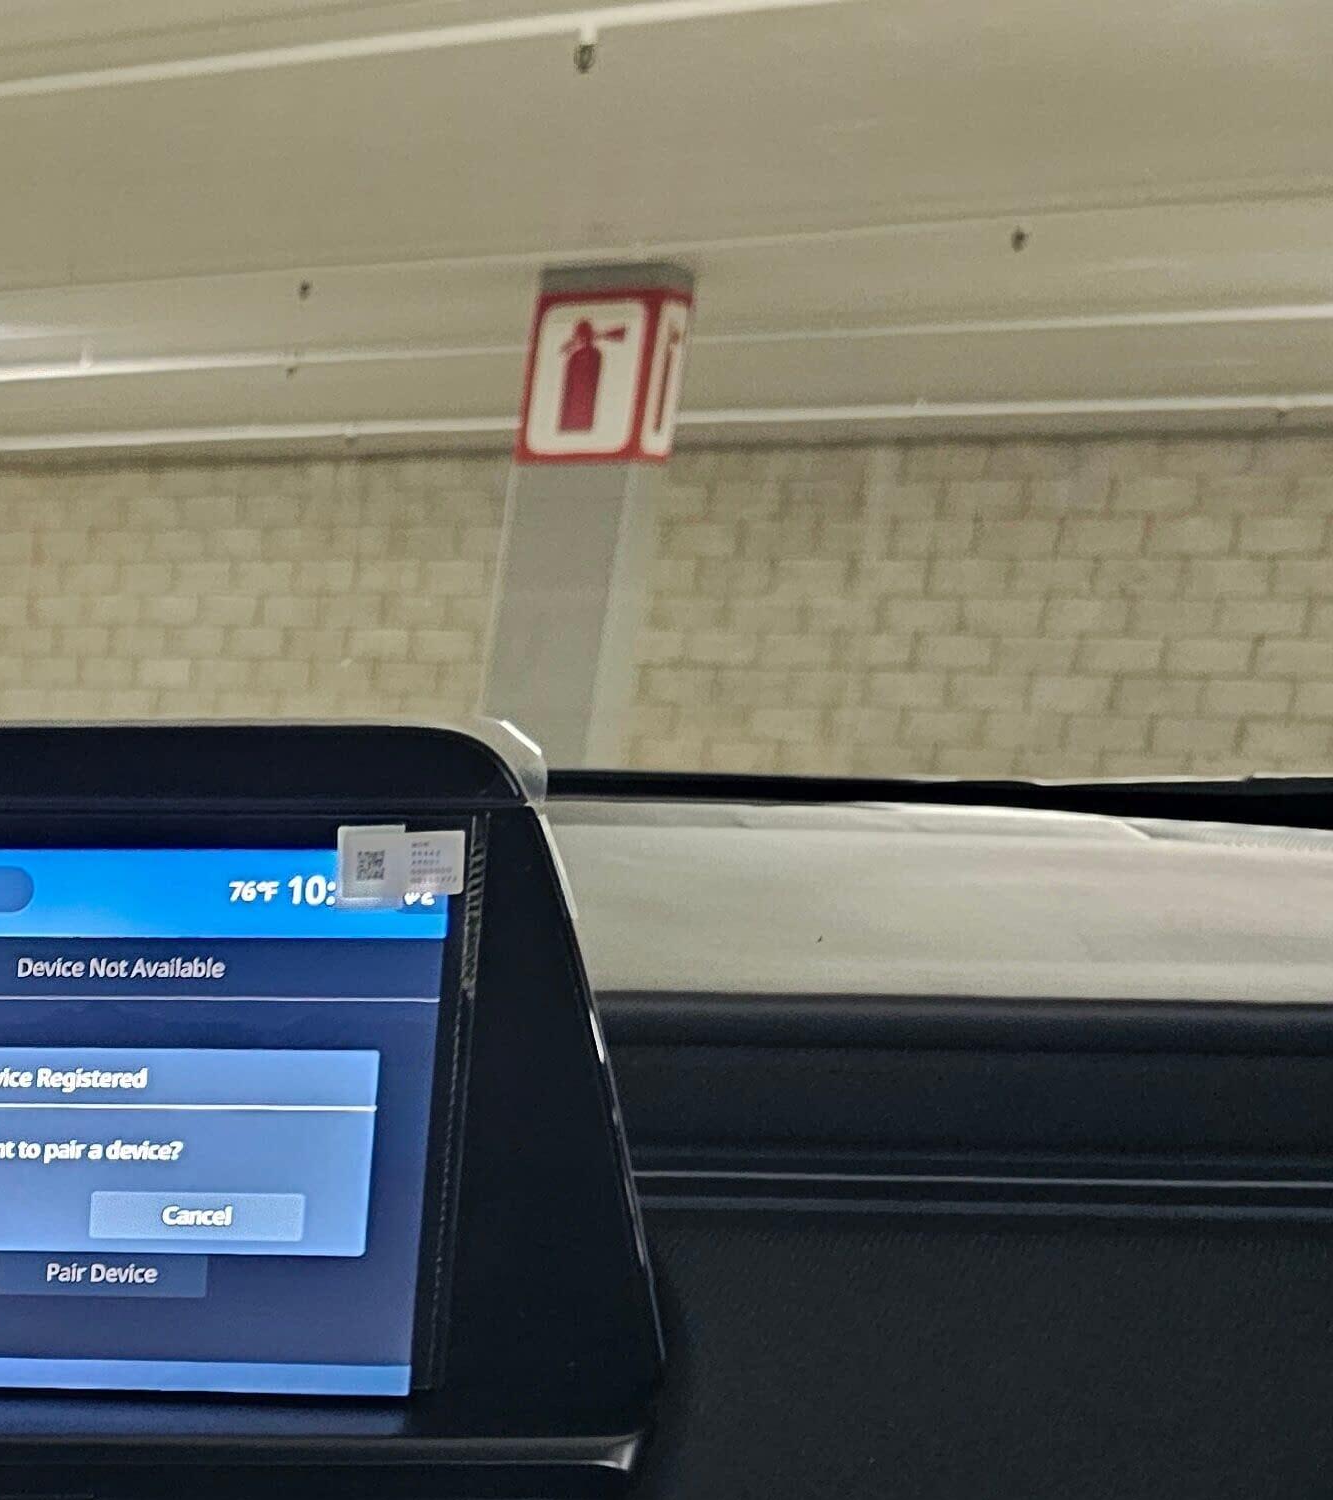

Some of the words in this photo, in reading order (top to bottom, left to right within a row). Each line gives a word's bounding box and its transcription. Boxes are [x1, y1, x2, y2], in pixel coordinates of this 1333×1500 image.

[287, 874, 337, 906] 10:
[16, 956, 84, 979] Device
[88, 957, 129, 979] Not
[130, 956, 226, 980] Available
[36, 1067, 149, 1093] Registered
[17, 1140, 42, 1159] to
[43, 1139, 86, 1164] pair
[87, 1144, 104, 1160] a
[105, 1139, 184, 1161] device?
[161, 1203, 234, 1228] Cancel
[46, 1262, 86, 1283] Pair
[90, 1262, 159, 1285] Device
